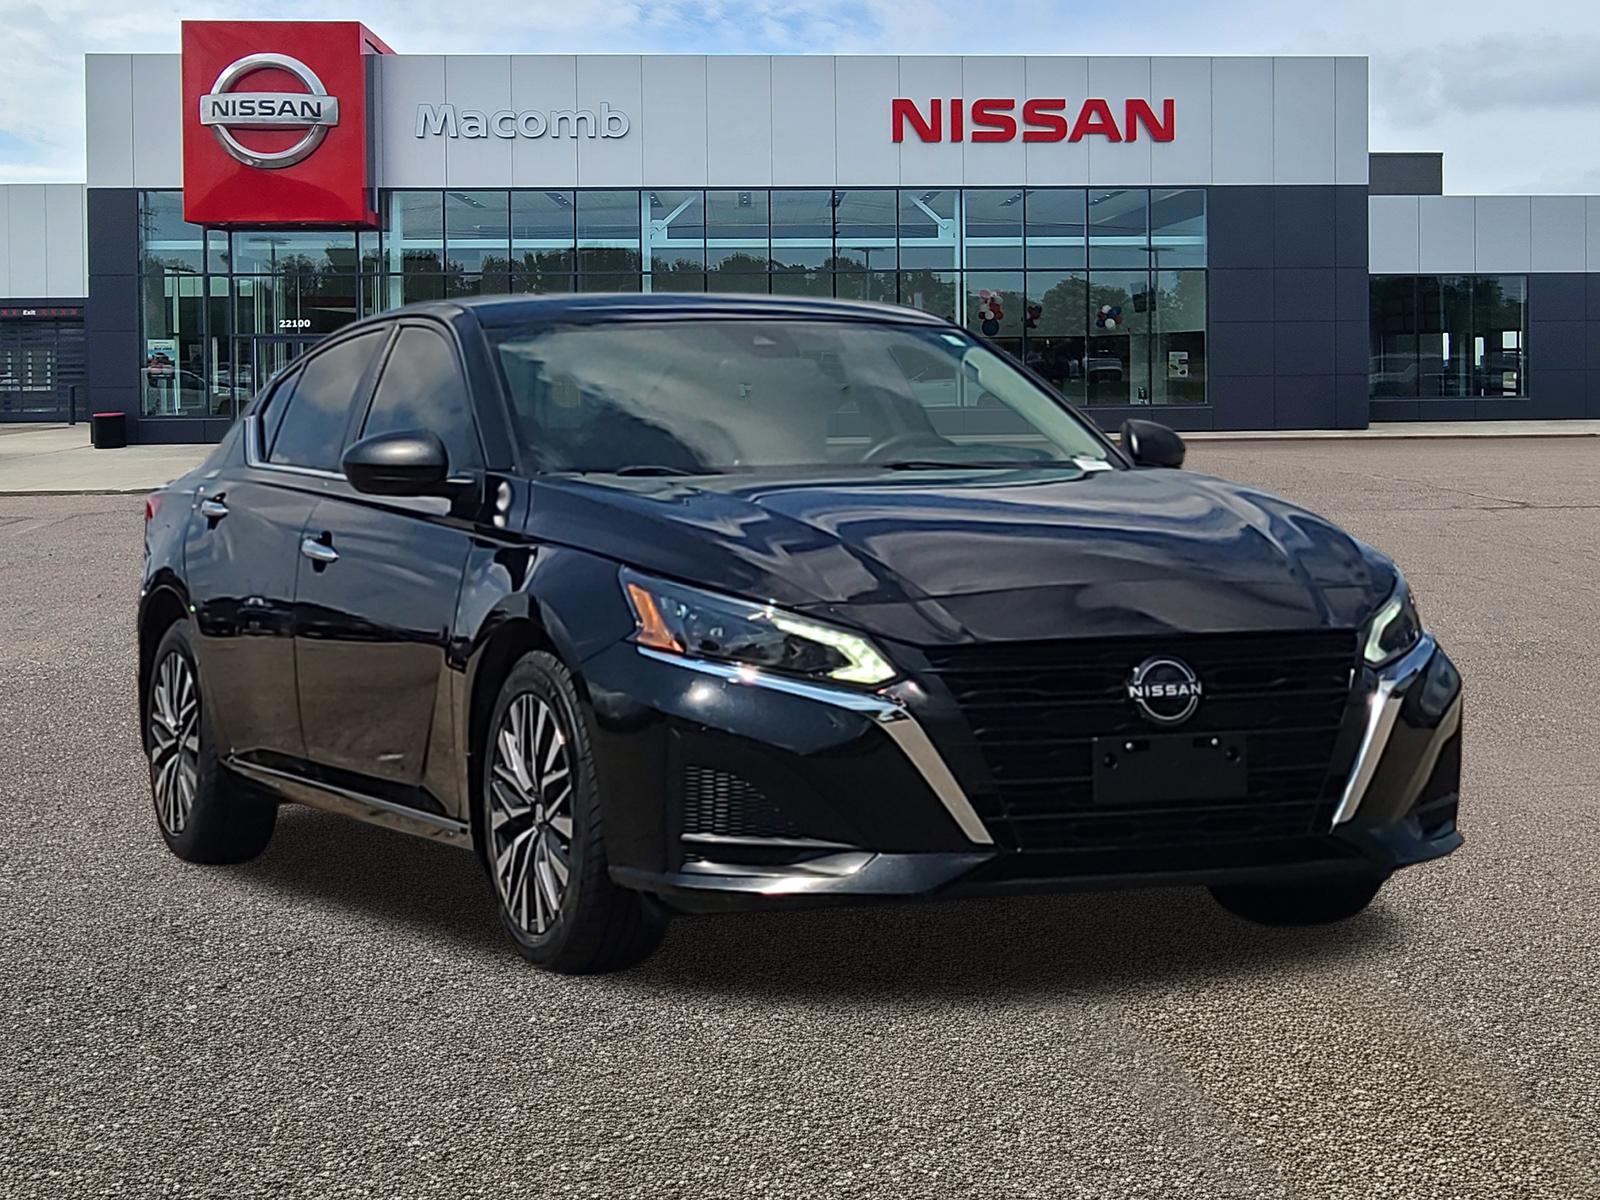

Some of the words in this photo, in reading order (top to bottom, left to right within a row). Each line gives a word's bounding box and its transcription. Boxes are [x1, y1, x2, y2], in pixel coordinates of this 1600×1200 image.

[212, 100, 321, 117] NISSAN
[415, 102, 630, 138] Macomb
[892, 98, 1174, 143] NISSAN
[279, 319, 311, 328] 22100
[1128, 681, 1202, 698] NISSAN
